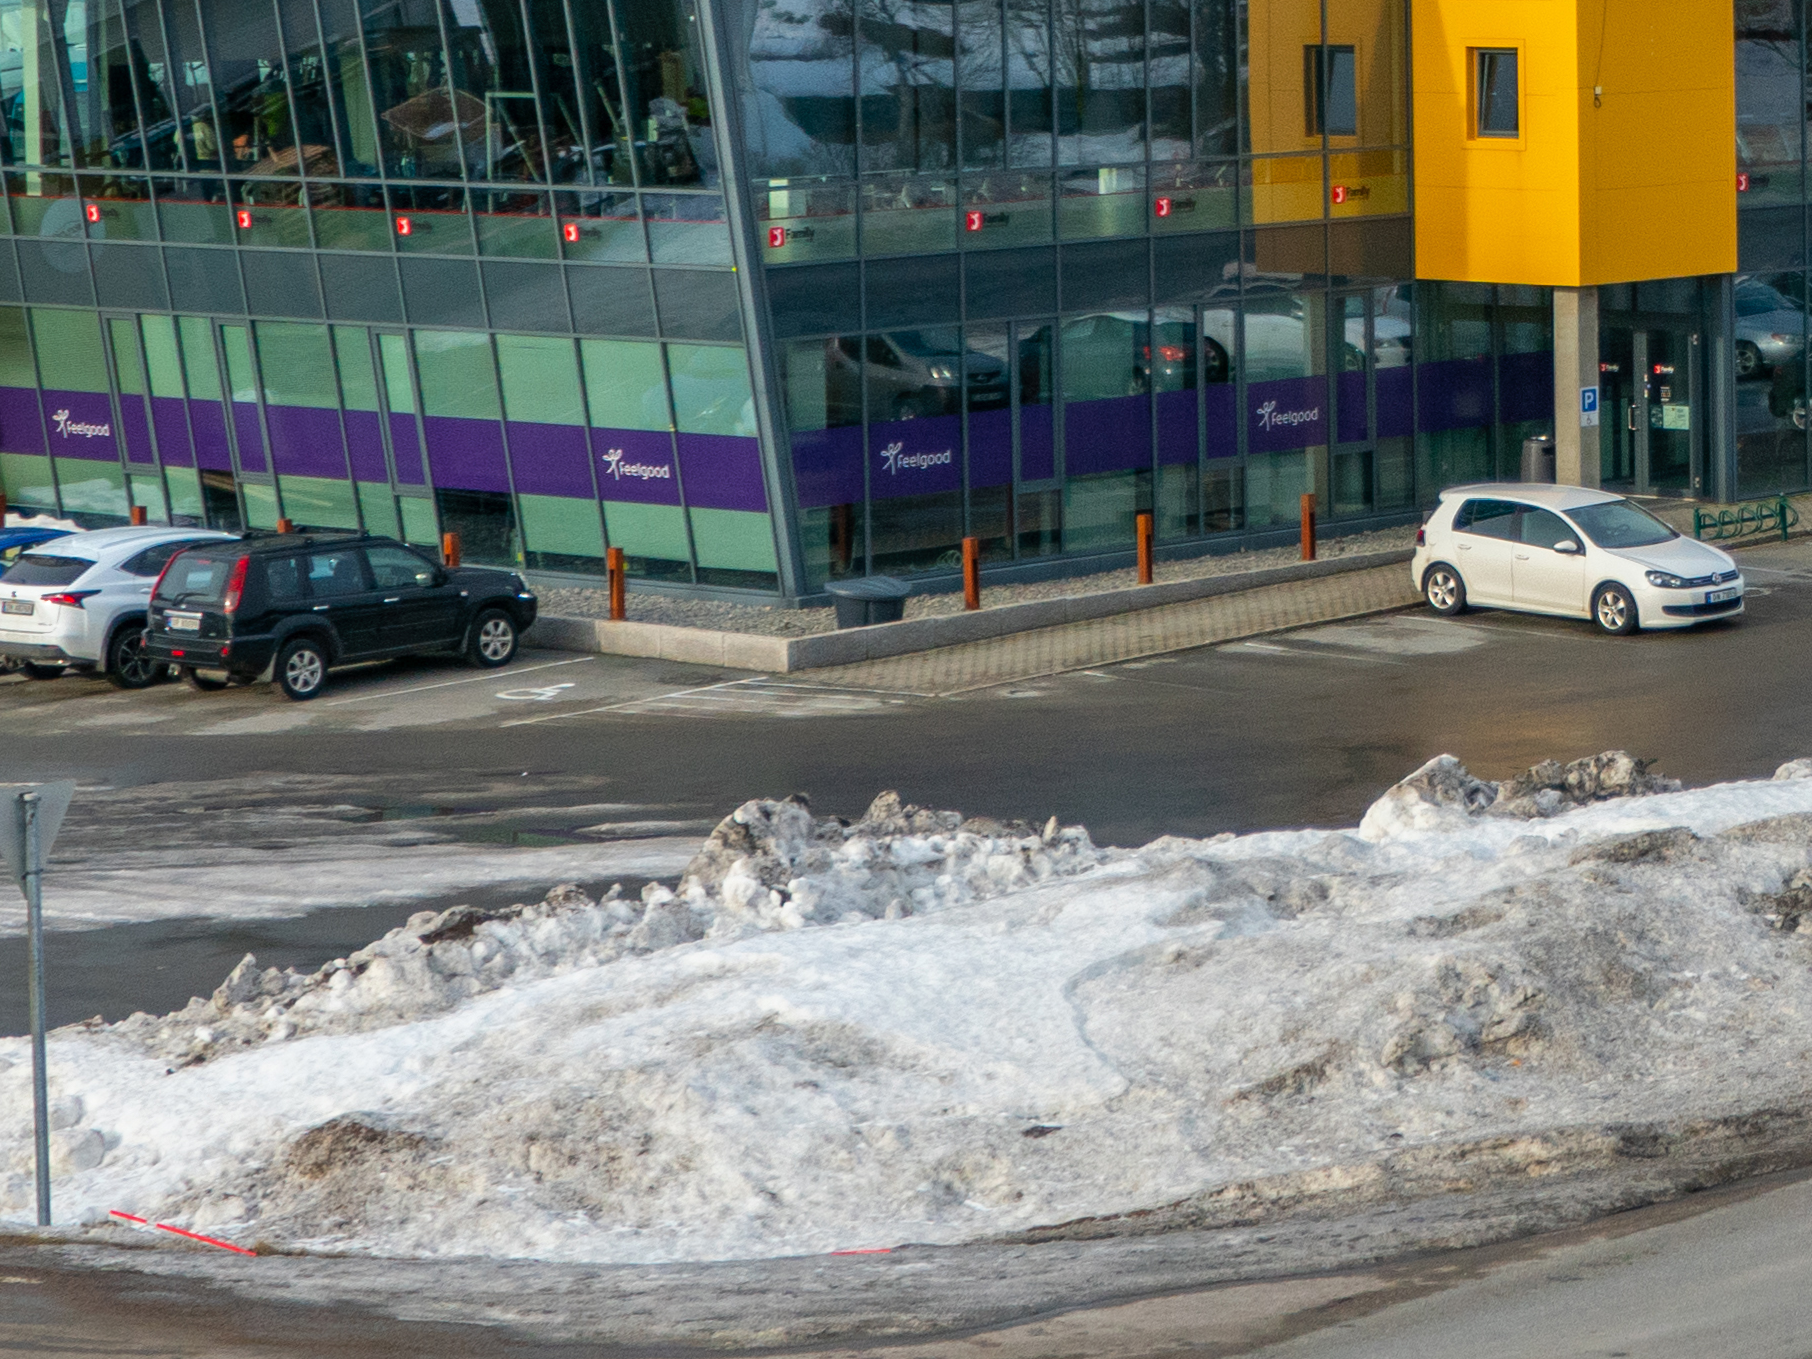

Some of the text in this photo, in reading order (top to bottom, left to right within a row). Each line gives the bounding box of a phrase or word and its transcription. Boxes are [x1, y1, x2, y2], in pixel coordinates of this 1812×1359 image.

[1584, 392, 1594, 410] P
[1271, 407, 1319, 426] Feelgood
[67, 421, 110, 438] Feelgood
[897, 448, 951, 469] Feelgood
[619, 461, 670, 480] Feelgood
